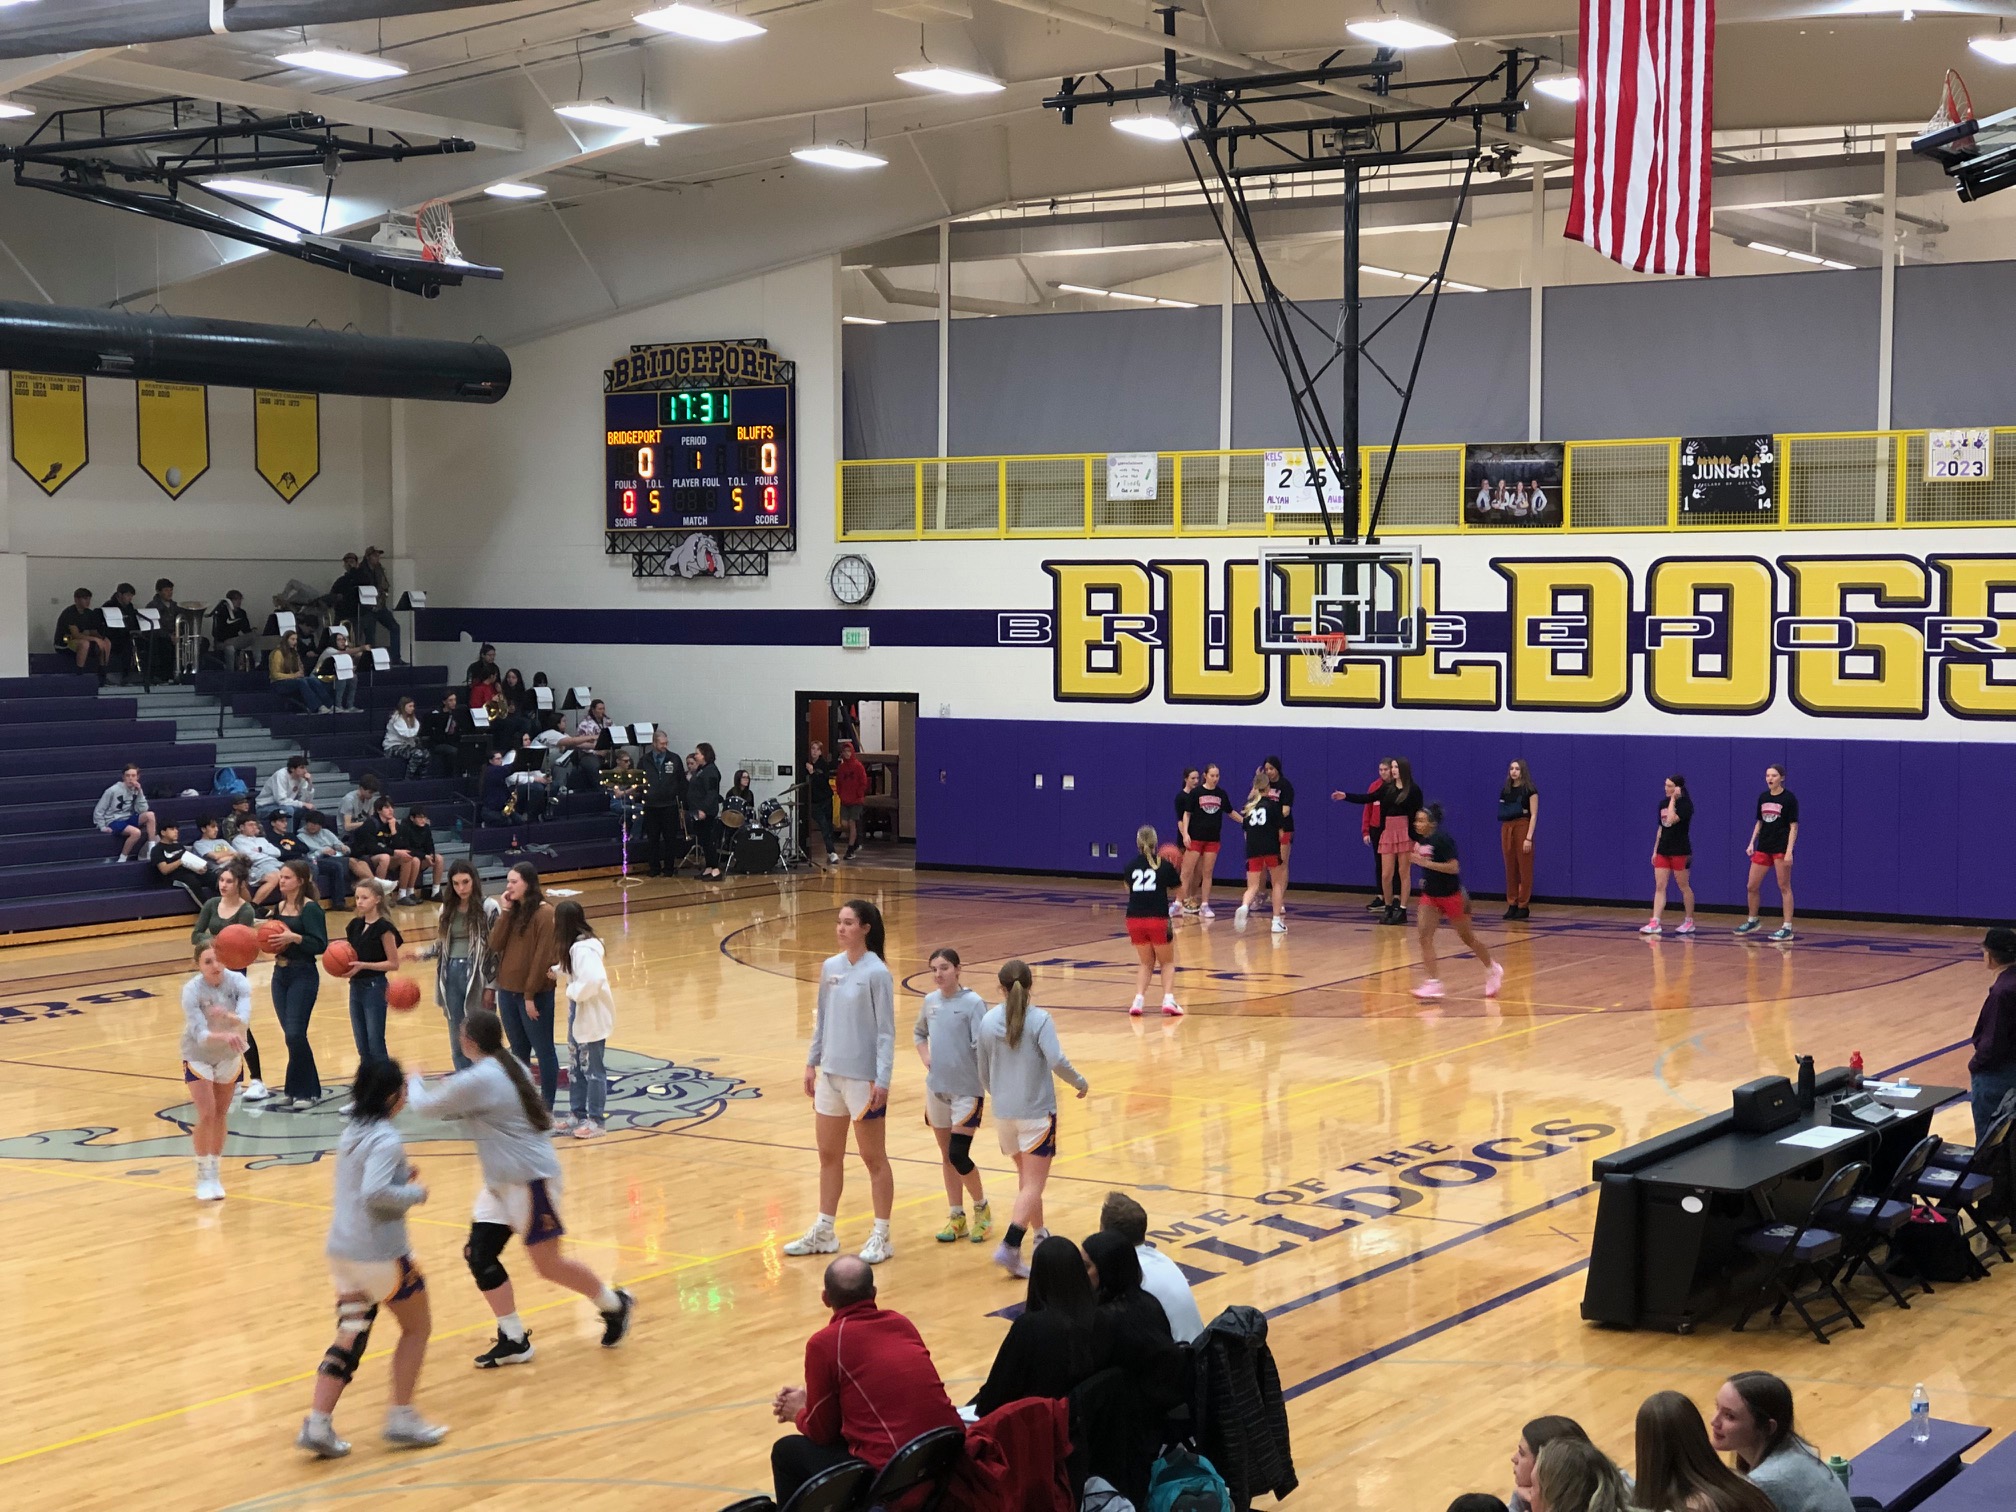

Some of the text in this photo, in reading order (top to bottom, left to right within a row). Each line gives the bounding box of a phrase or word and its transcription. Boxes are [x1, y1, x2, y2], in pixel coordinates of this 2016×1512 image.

[613, 343, 779, 388] BRIDGEPORT
[670, 392, 728, 422] 17:31
[607, 429, 662, 444] BRIDGEPORT
[737, 425, 774, 440] BLUFFS
[681, 436, 707, 446] PERIOD
[638, 447, 653, 478] 0
[695, 450, 701, 470] 1
[761, 443, 776, 474] 0
[1682, 455, 1694, 466] 15
[1759, 453, 1774, 464] 30
[1936, 461, 1984, 476] 2023
[614, 480, 637, 489] FOULS
[645, 479, 665, 488] T.O.L.
[672, 477, 720, 487] PLAYER FOUL
[727, 477, 748, 486] T.O.L.
[755, 476, 778, 485] FOULS
[623, 490, 636, 514] 0
[650, 490, 660, 514] 5
[732, 487, 743, 511] 5
[764, 486, 777, 511] 0
[1758, 498, 1771, 510] 14
[614, 518, 637, 527] SCORE
[683, 516, 708, 526] MATCH
[755, 515, 779, 524] SCORE
[846, 632, 861, 644] EXIT
[1249, 807, 1267, 826] 33
[1131, 868, 1157, 891] 22
[1255, 1177, 1329, 1207] OF
[1337, 1139, 1456, 1176] THE
[1172, 1118, 1617, 1287] LLDOGS
